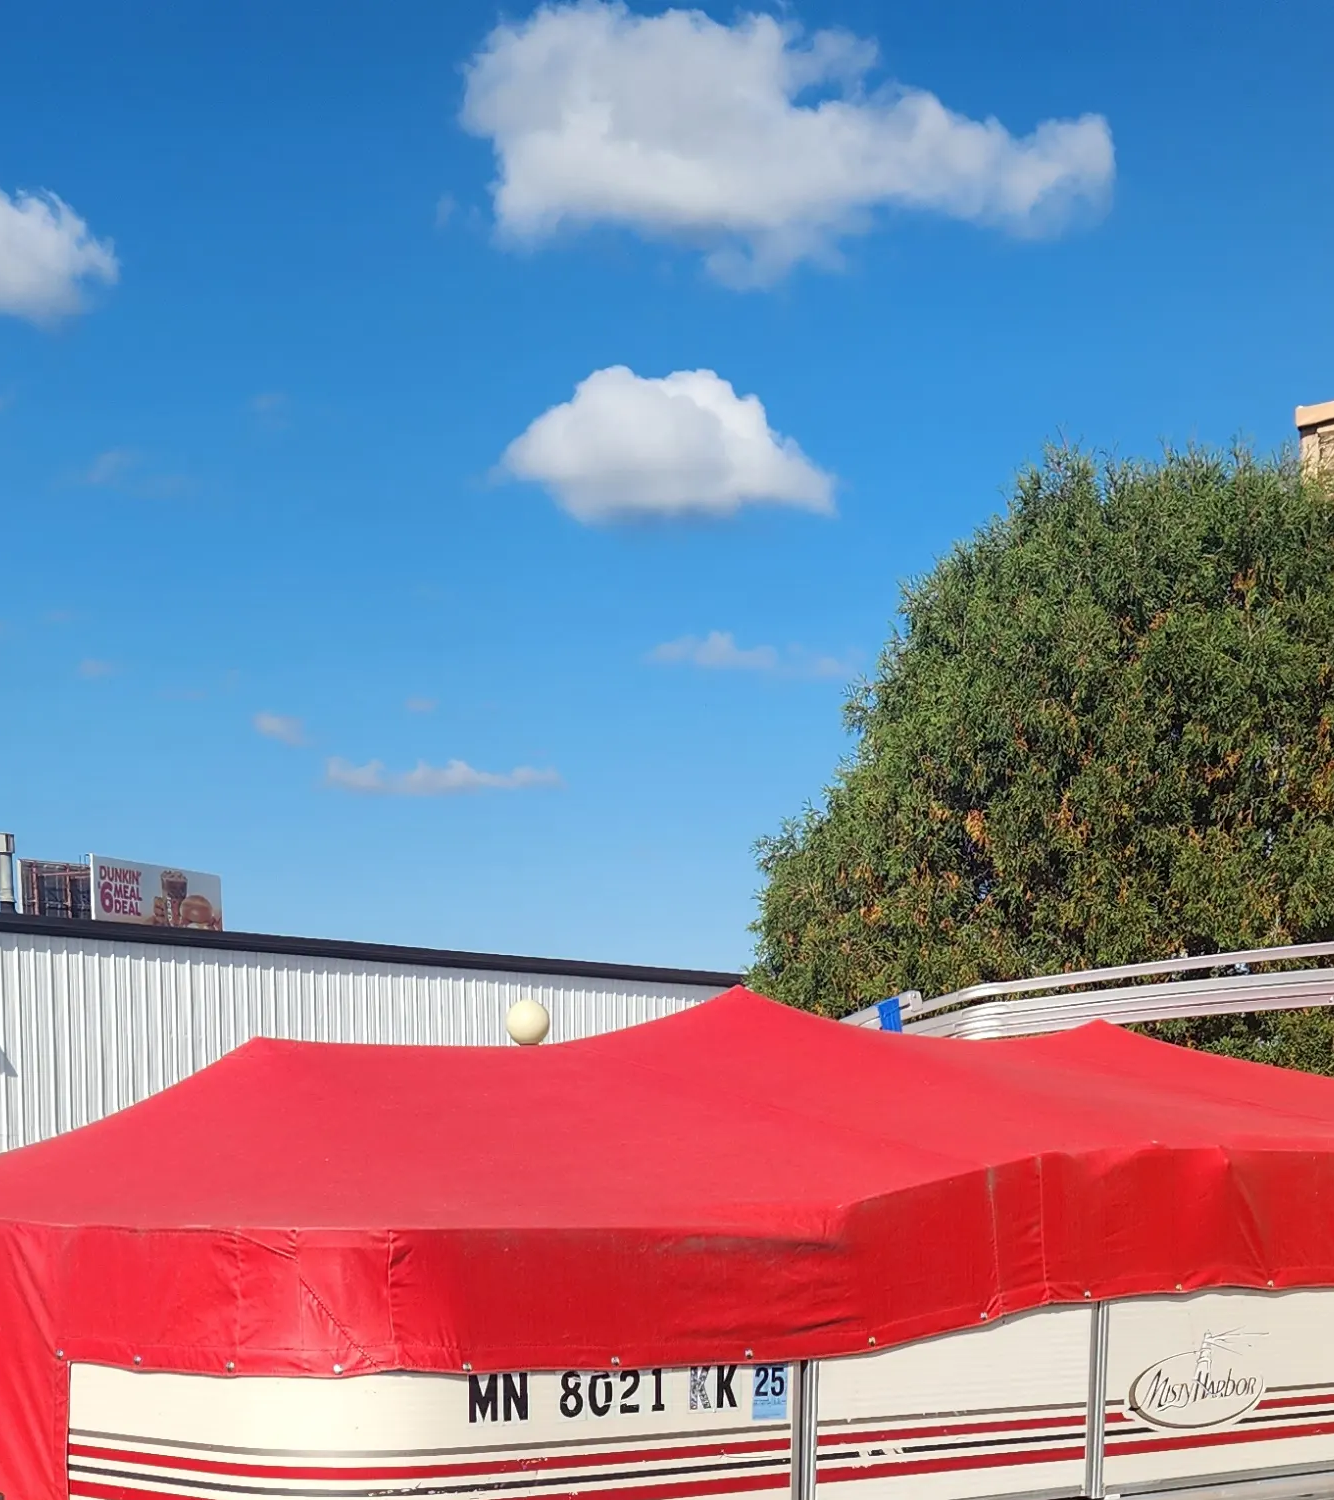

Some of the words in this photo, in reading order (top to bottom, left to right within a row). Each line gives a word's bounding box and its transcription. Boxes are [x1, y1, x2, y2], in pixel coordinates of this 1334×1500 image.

[99, 865, 142, 886] DUNKIN'
[114, 883, 142, 901] MEAL
[114, 898, 142, 917] DEAL
[755, 1366, 785, 1397] 25
[468, 1373, 529, 1424] MN
[559, 1366, 665, 1419] 8021
[689, 1364, 738, 1410] KK
